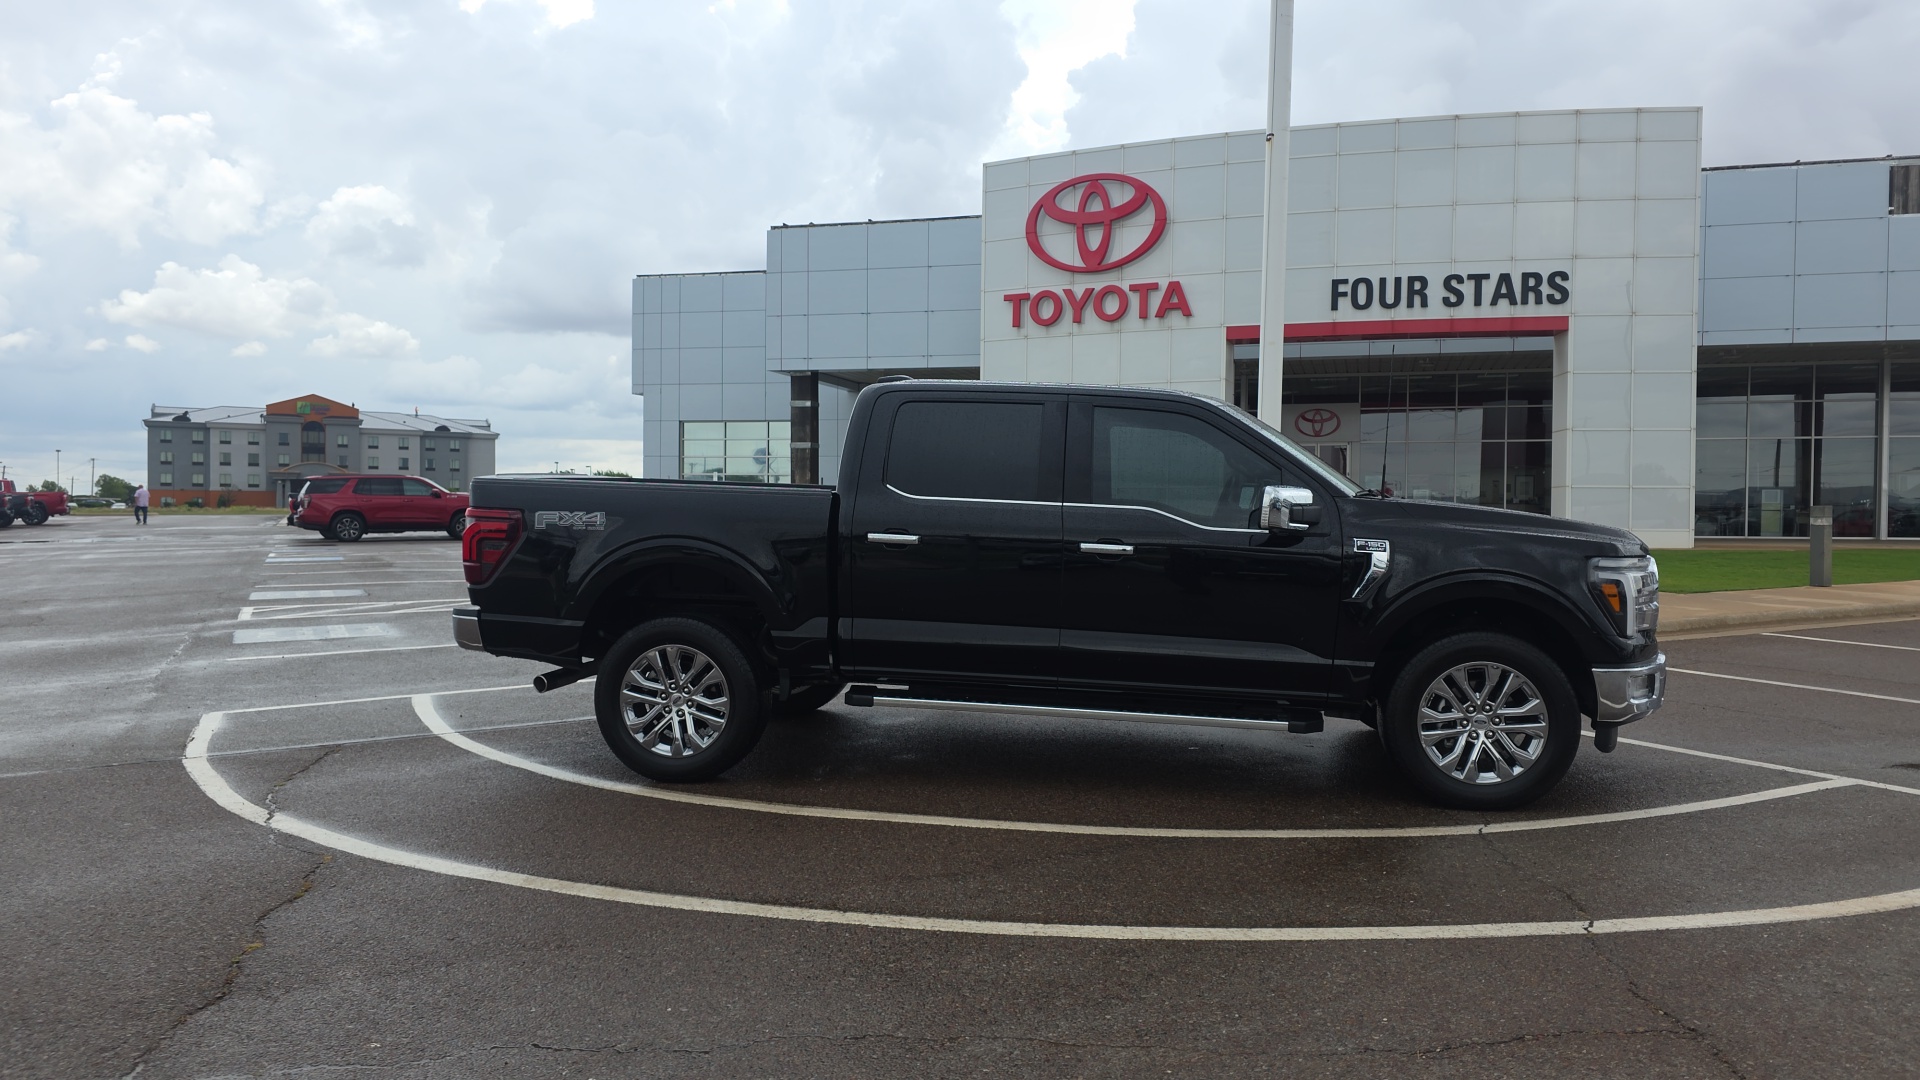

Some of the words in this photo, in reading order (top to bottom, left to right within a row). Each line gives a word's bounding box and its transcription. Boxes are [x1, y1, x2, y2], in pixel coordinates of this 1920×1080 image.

[1003, 280, 1193, 328] TOYOTA
[1331, 275, 1429, 311] FOUR
[1442, 271, 1570, 308] STARS
[534, 511, 607, 530] FX4
